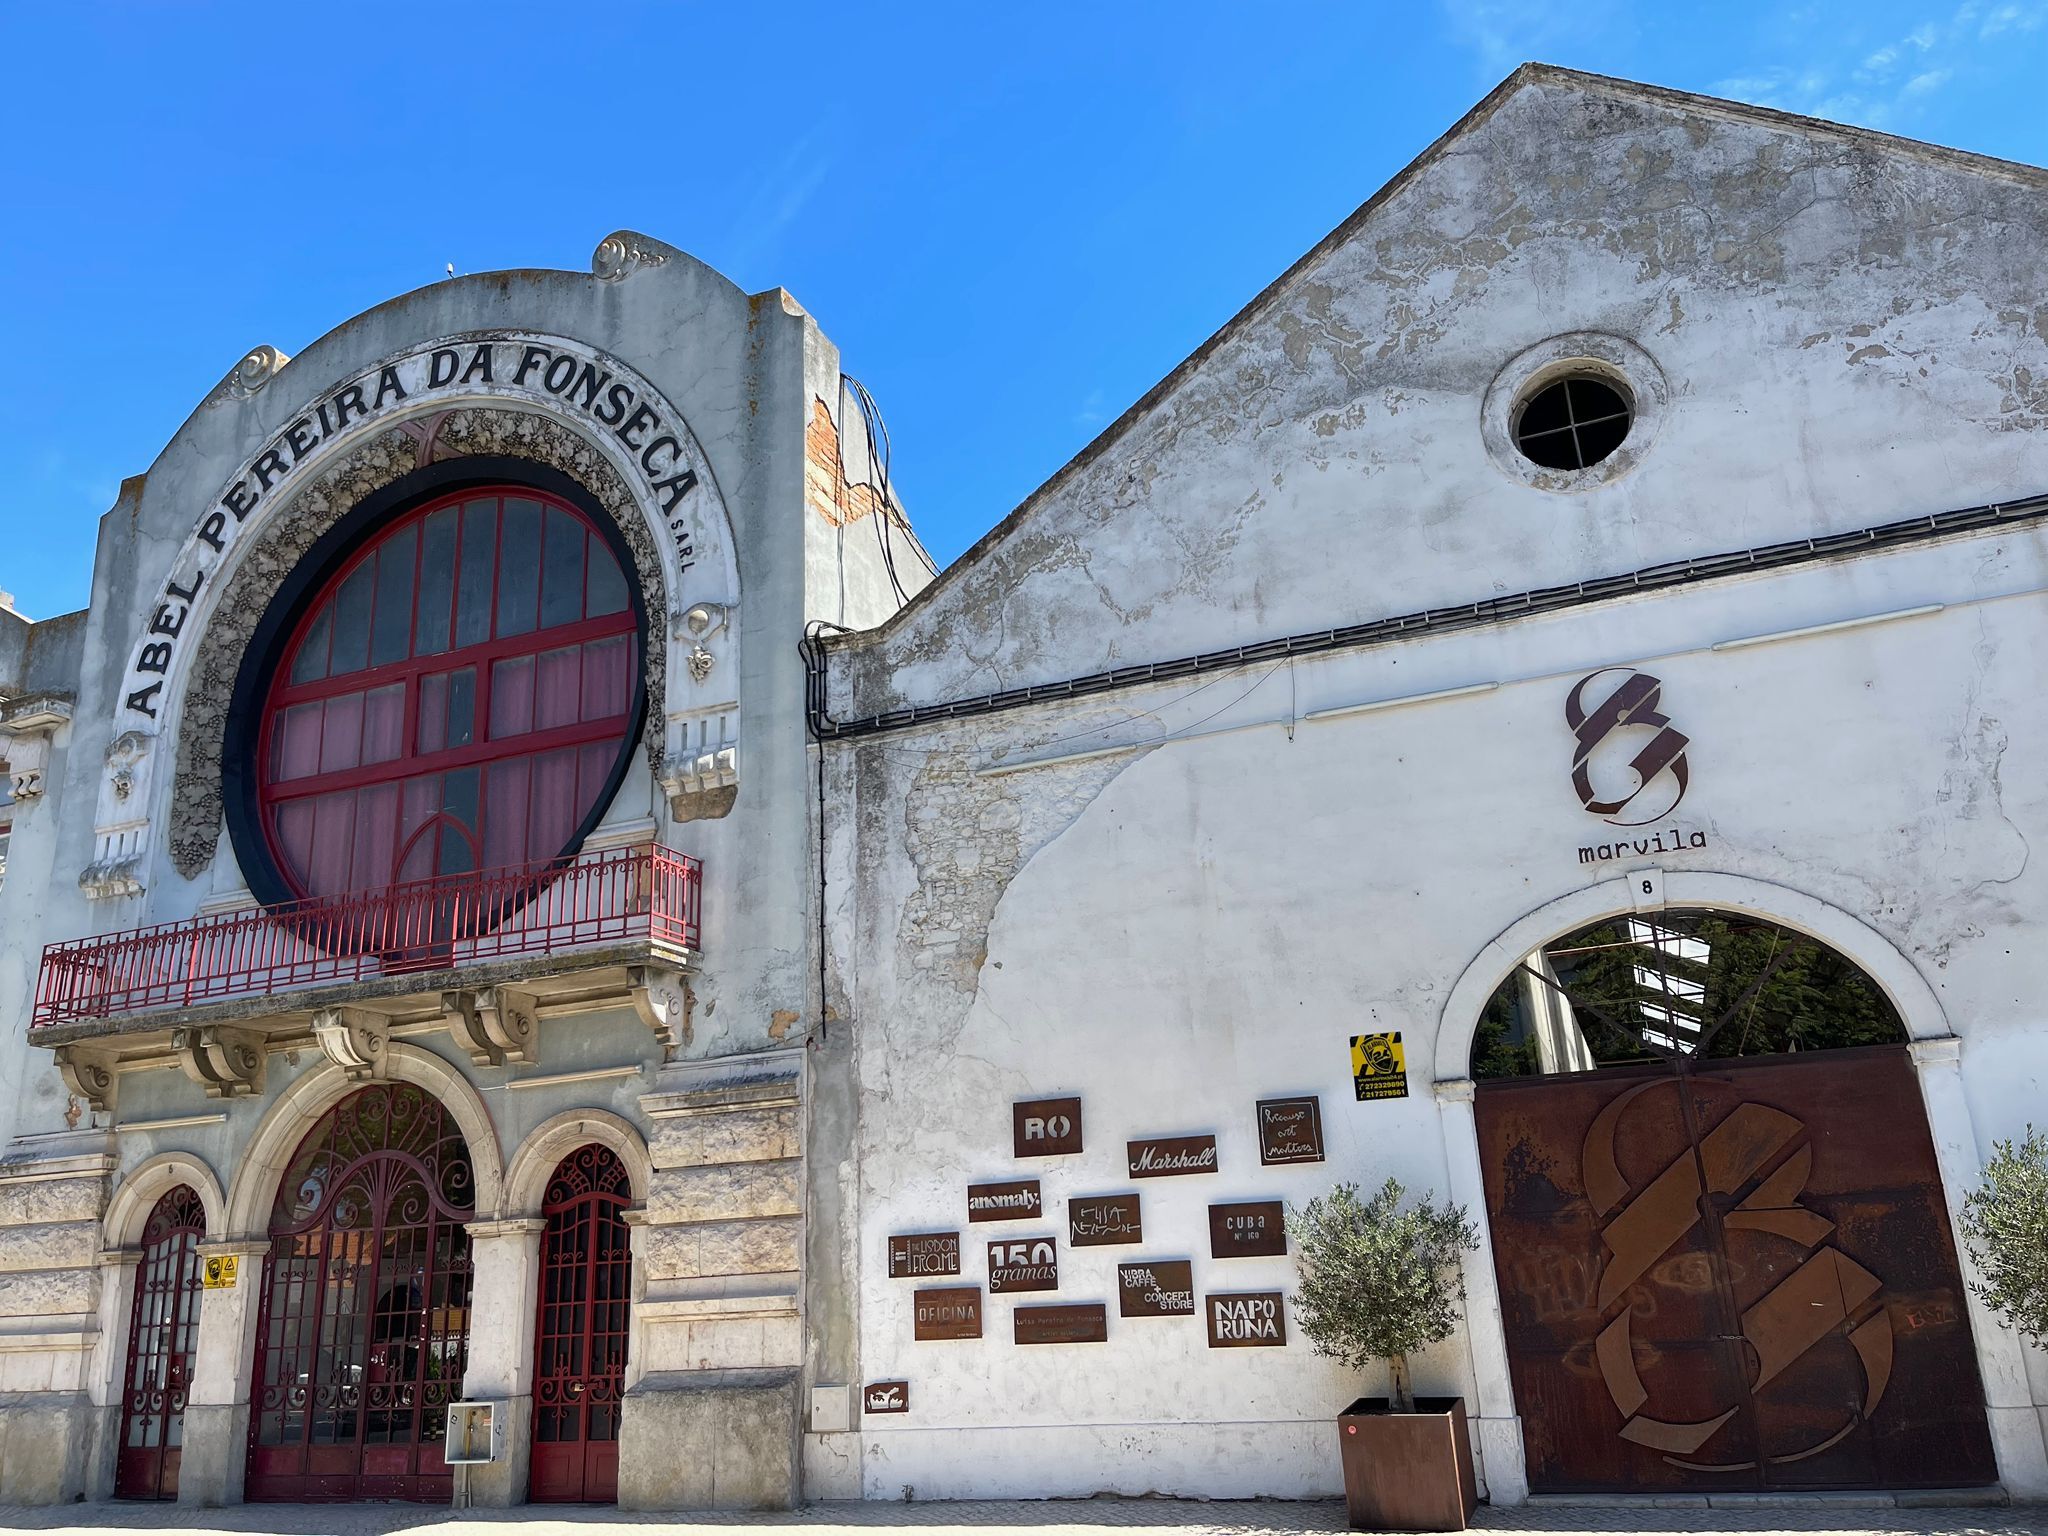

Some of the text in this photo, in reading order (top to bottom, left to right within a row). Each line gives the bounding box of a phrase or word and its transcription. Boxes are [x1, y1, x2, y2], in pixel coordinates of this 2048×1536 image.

[126, 344, 699, 719] ABEL PEREIRA DA FONSECA
[1578, 829, 1707, 864] marvila
[1641, 880, 1653, 894] 8
[578, 1121, 585, 1134] 7
[1024, 1115, 1071, 1140] RO
[1130, 1146, 1216, 1172] Marshall
[990, 1242, 1055, 1267] 150
[990, 1265, 1057, 1290] gramas
[1144, 1291, 1191, 1303] CONCEPT
[1160, 1300, 1194, 1310] STORE
[919, 1305, 975, 1322] OFICINA
[1215, 1300, 1276, 1320] NAPO
[1216, 1318, 1279, 1340] RUNA
